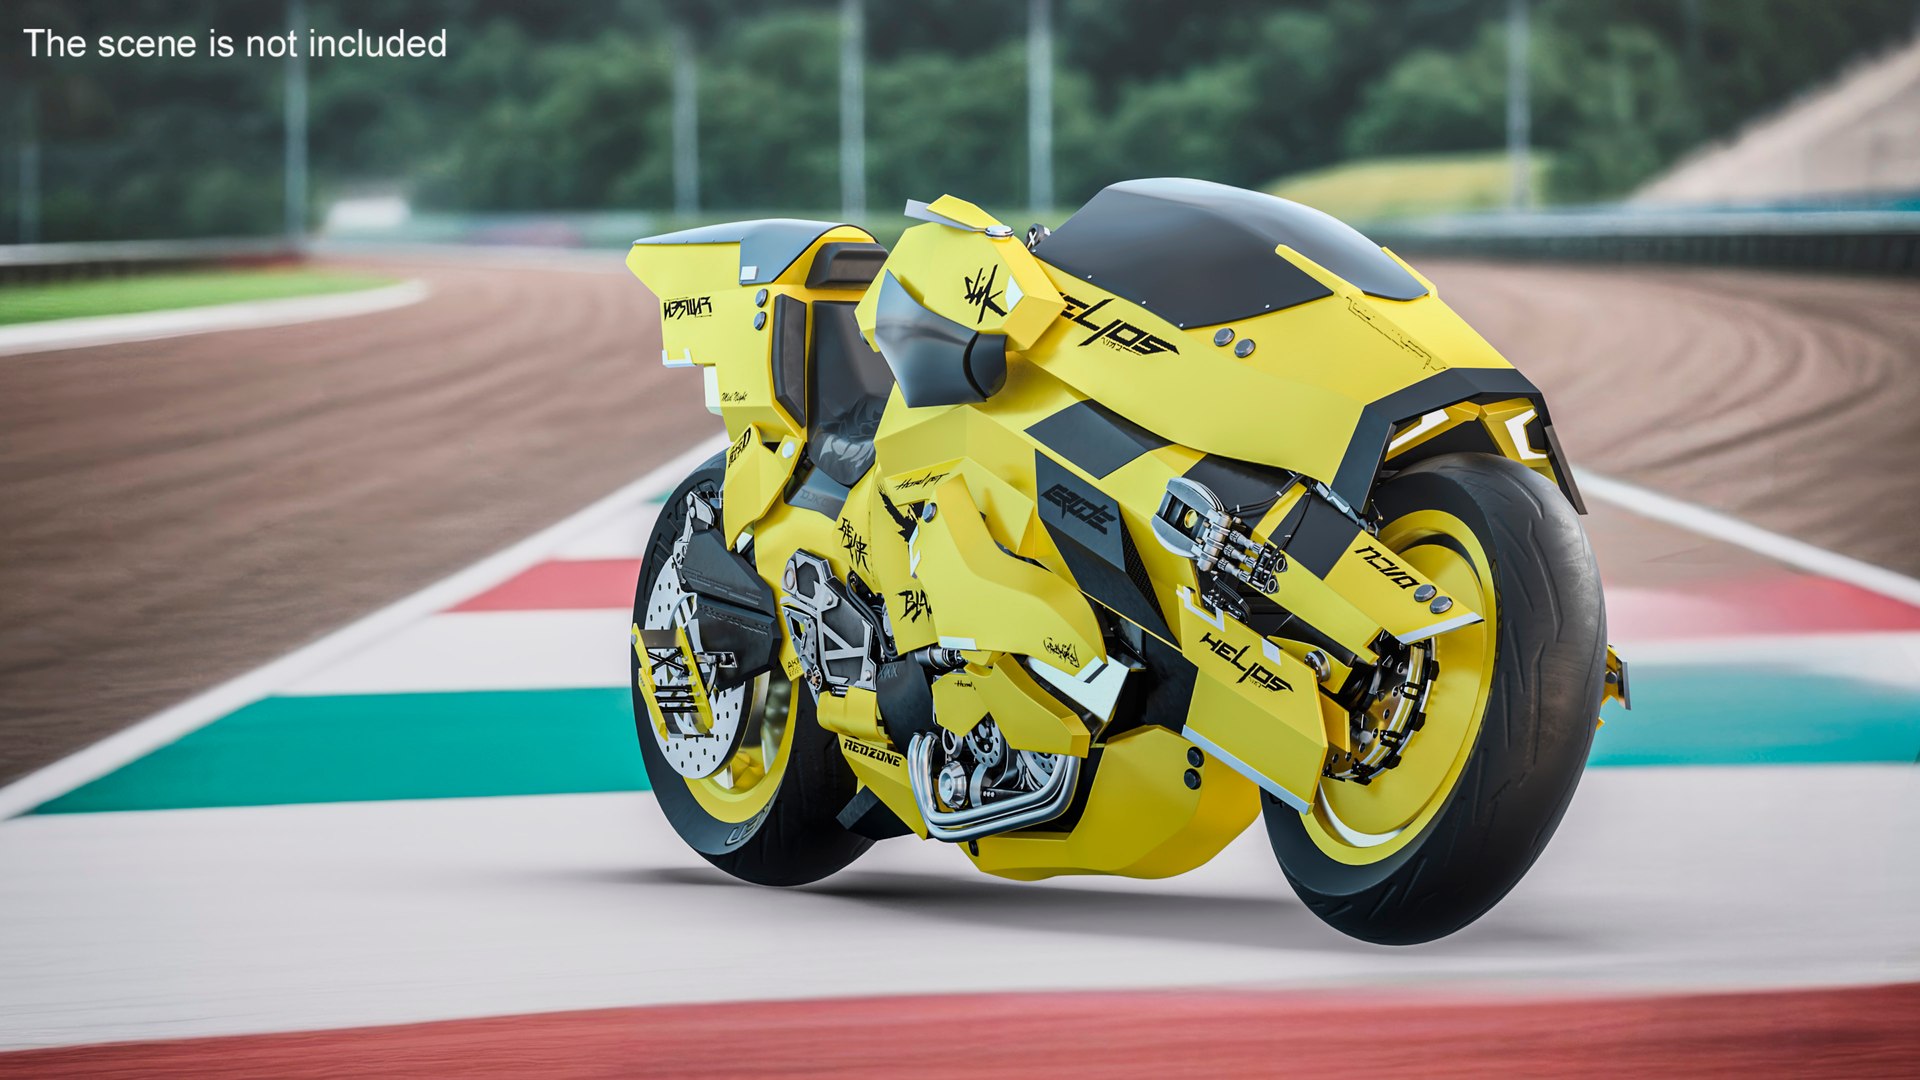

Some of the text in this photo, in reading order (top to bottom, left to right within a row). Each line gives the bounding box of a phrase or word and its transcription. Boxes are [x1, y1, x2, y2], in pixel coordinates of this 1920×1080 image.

[1058, 291, 1181, 355] ELIOS
[1199, 632, 1294, 692] HELIOS
[844, 738, 903, 768] REDZONE
